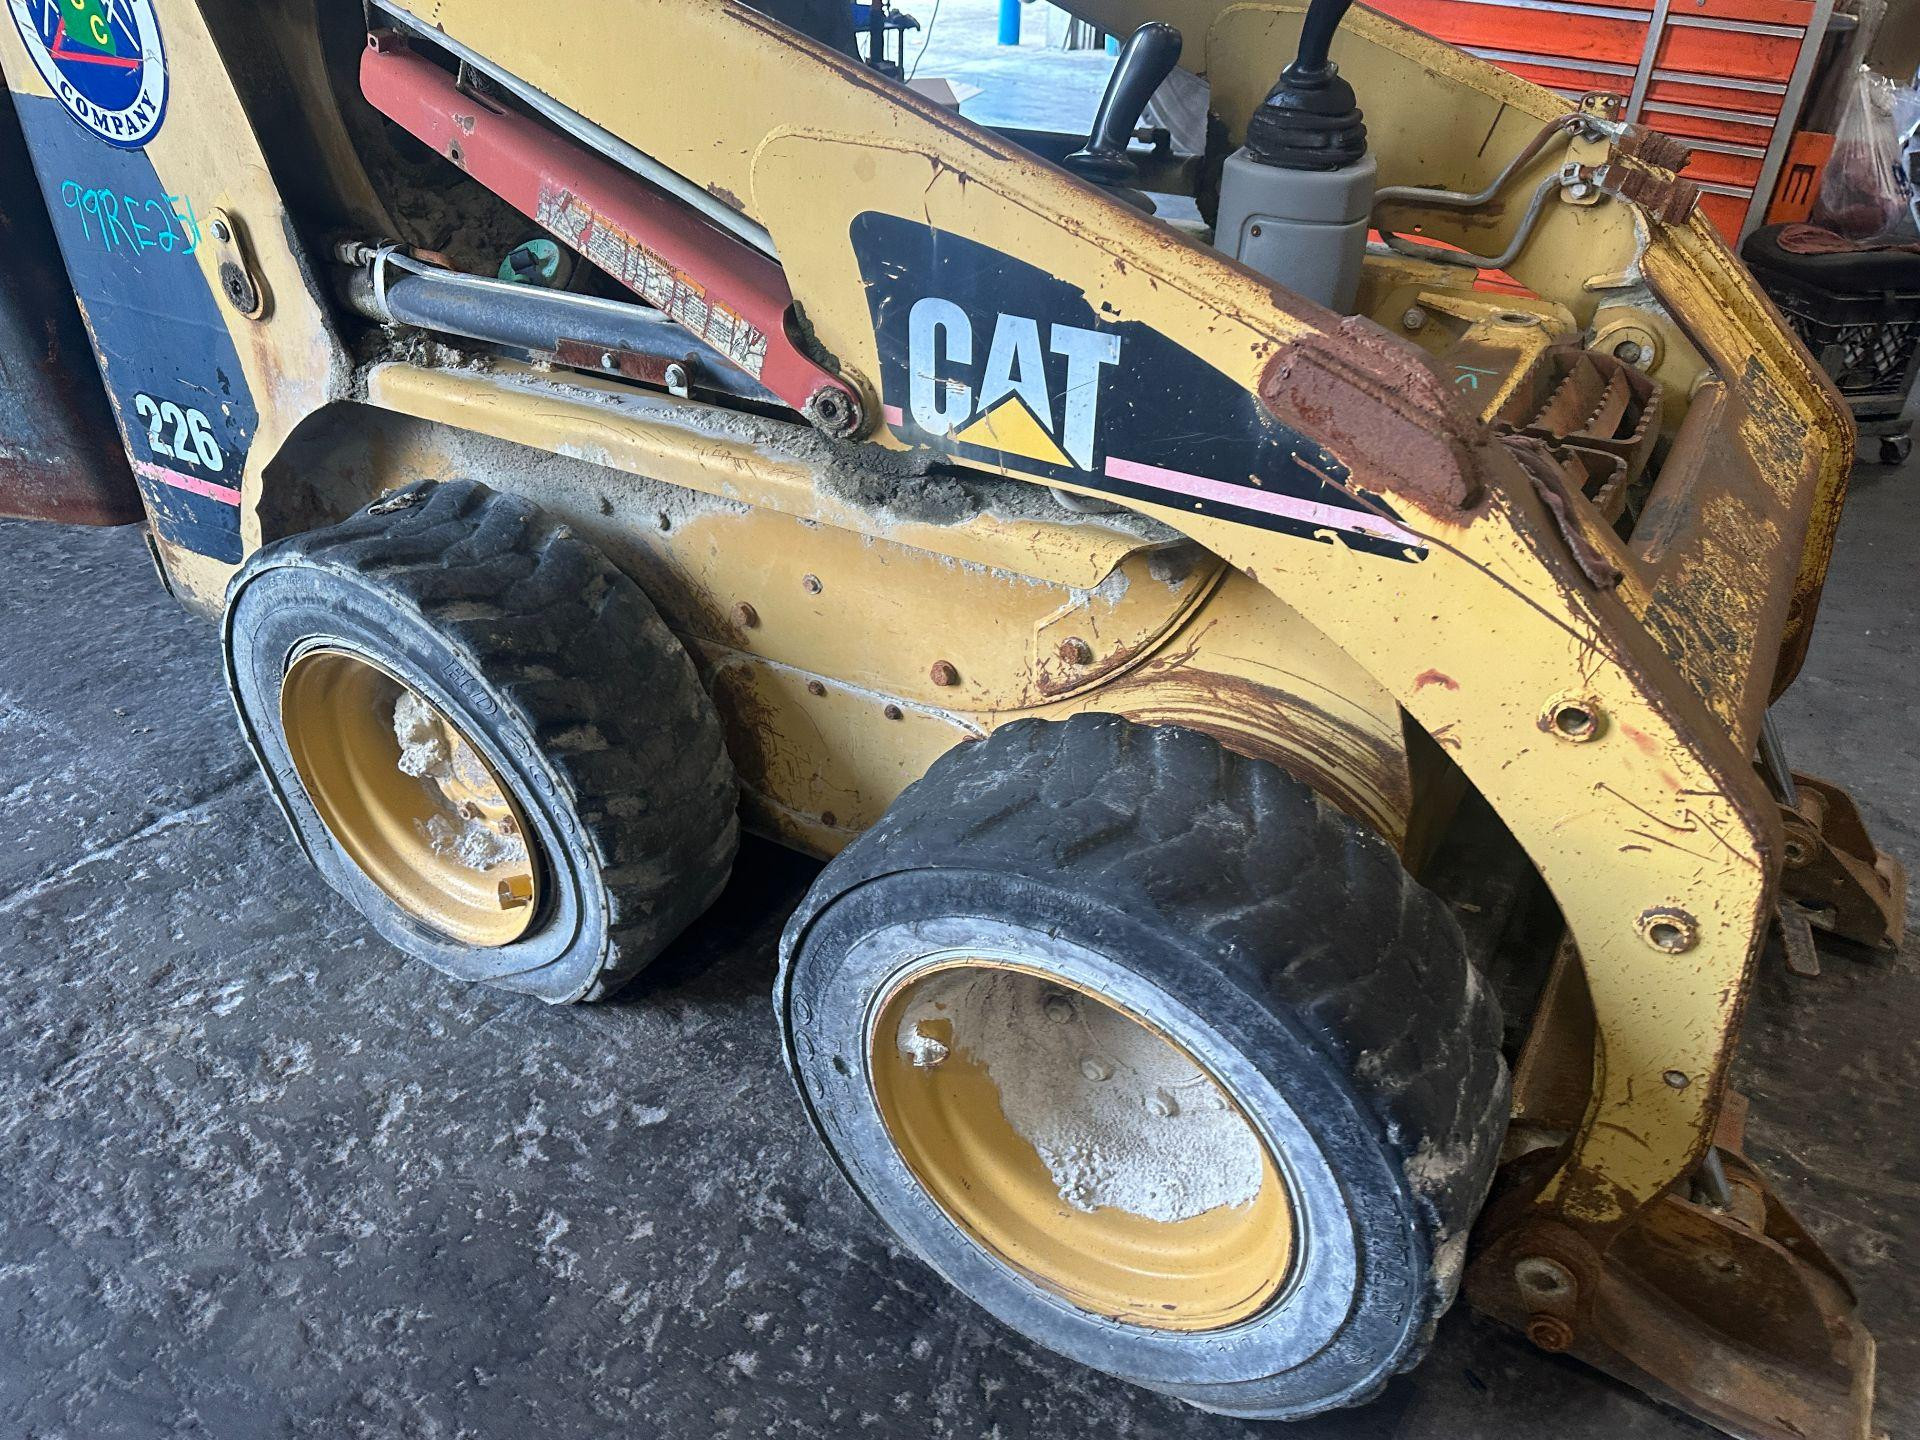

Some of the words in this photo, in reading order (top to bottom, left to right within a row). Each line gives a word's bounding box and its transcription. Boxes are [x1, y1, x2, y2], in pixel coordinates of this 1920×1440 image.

[60, 81, 157, 136] COMPANY
[909, 297, 1122, 472] CAT
[135, 393, 224, 473] 226
